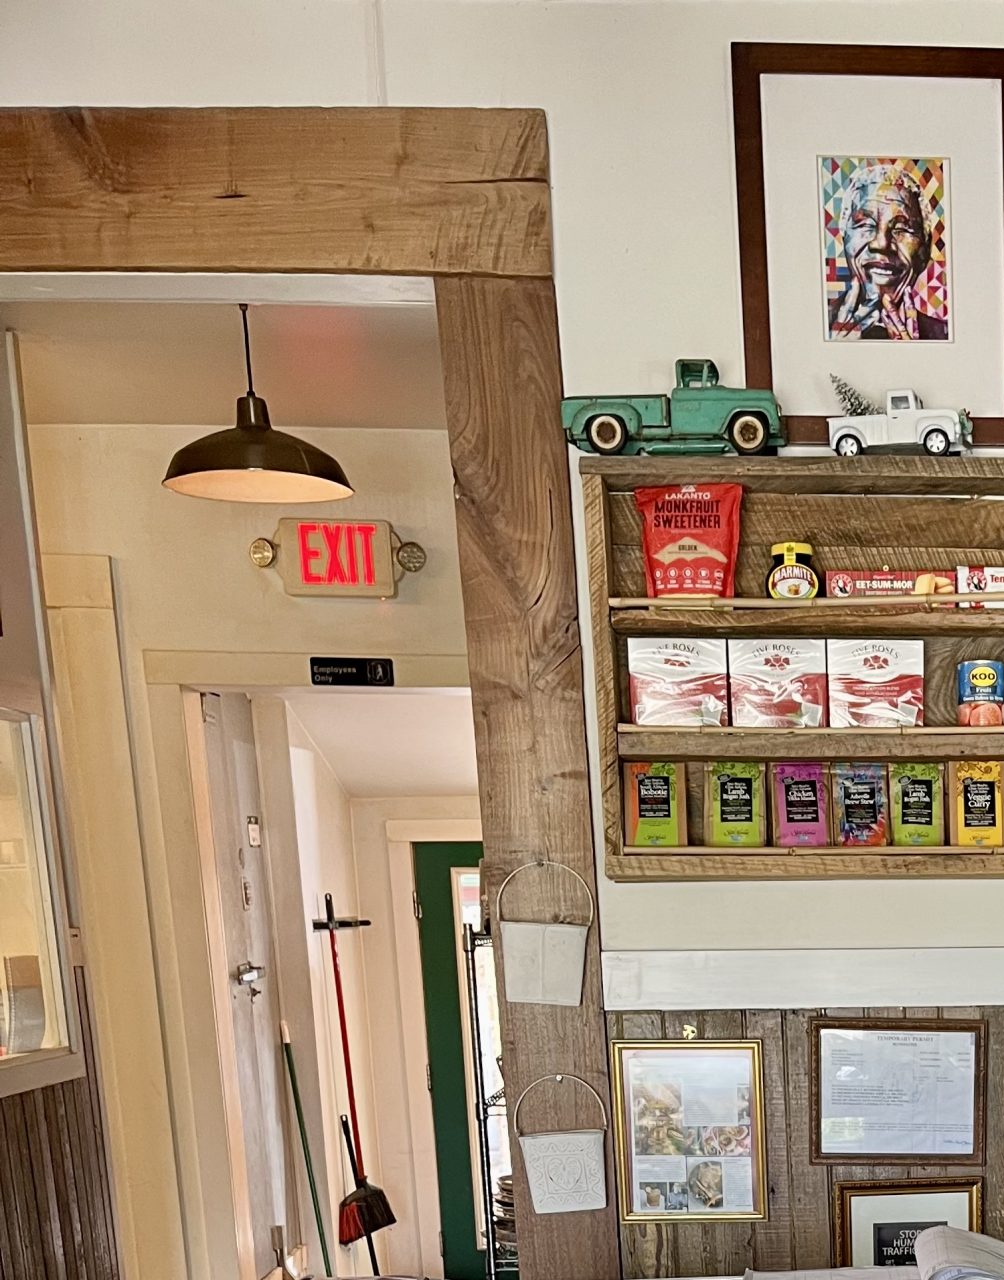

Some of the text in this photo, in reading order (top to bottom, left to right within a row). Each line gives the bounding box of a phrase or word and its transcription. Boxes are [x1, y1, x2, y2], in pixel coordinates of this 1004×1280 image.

[665, 492, 711, 500] LAKANTO
[654, 500, 720, 514] MONKFRUIT
[653, 515, 720, 529] SWEETENER
[298, 523, 376, 586] EXIT
[773, 565, 813, 582] MARMITE
[855, 580, 913, 589] EET-SUM-MOR
[313, 665, 357, 675] Employees
[314, 674, 333, 683] Only
[967, 793, 992, 802] Veggie
[968, 800, 991, 810] Curry
